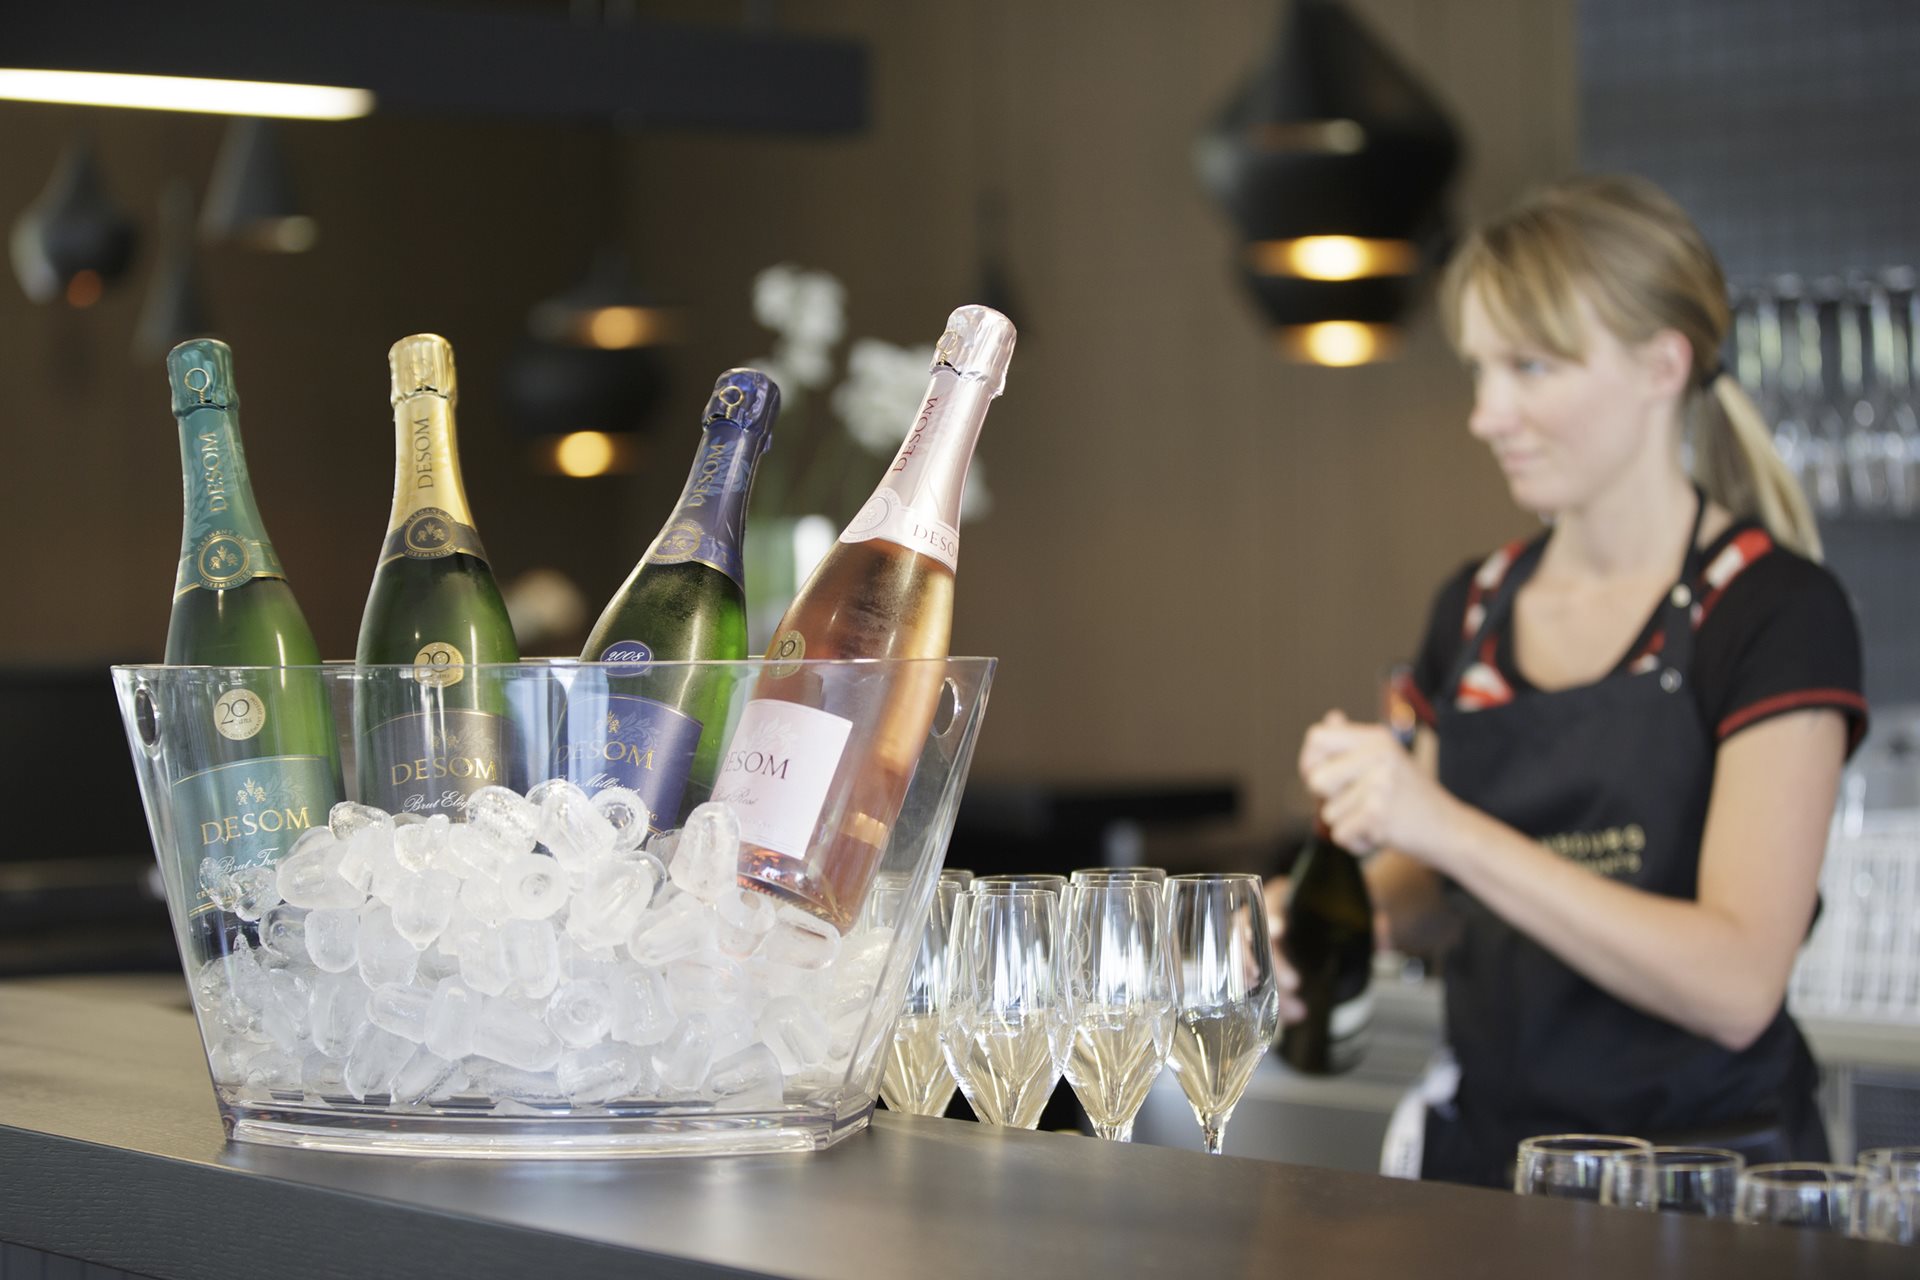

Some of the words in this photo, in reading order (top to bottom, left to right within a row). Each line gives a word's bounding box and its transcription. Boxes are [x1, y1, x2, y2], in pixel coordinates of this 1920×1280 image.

[892, 396, 938, 472] DESOM
[413, 417, 434, 489] DESOM
[198, 431, 230, 513] DESOM
[687, 443, 727, 508] DESOM
[912, 523, 958, 561] DESO
[604, 650, 646, 662] 2008
[217, 698, 250, 724] 20
[556, 740, 656, 770] DESOM
[725, 750, 790, 780] ESOM
[391, 757, 497, 786] DESOM
[402, 793, 441, 813] Brut
[200, 806, 312, 845] DESOM
[217, 855, 251, 875] Brut
[253, 847, 280, 868] Tra
